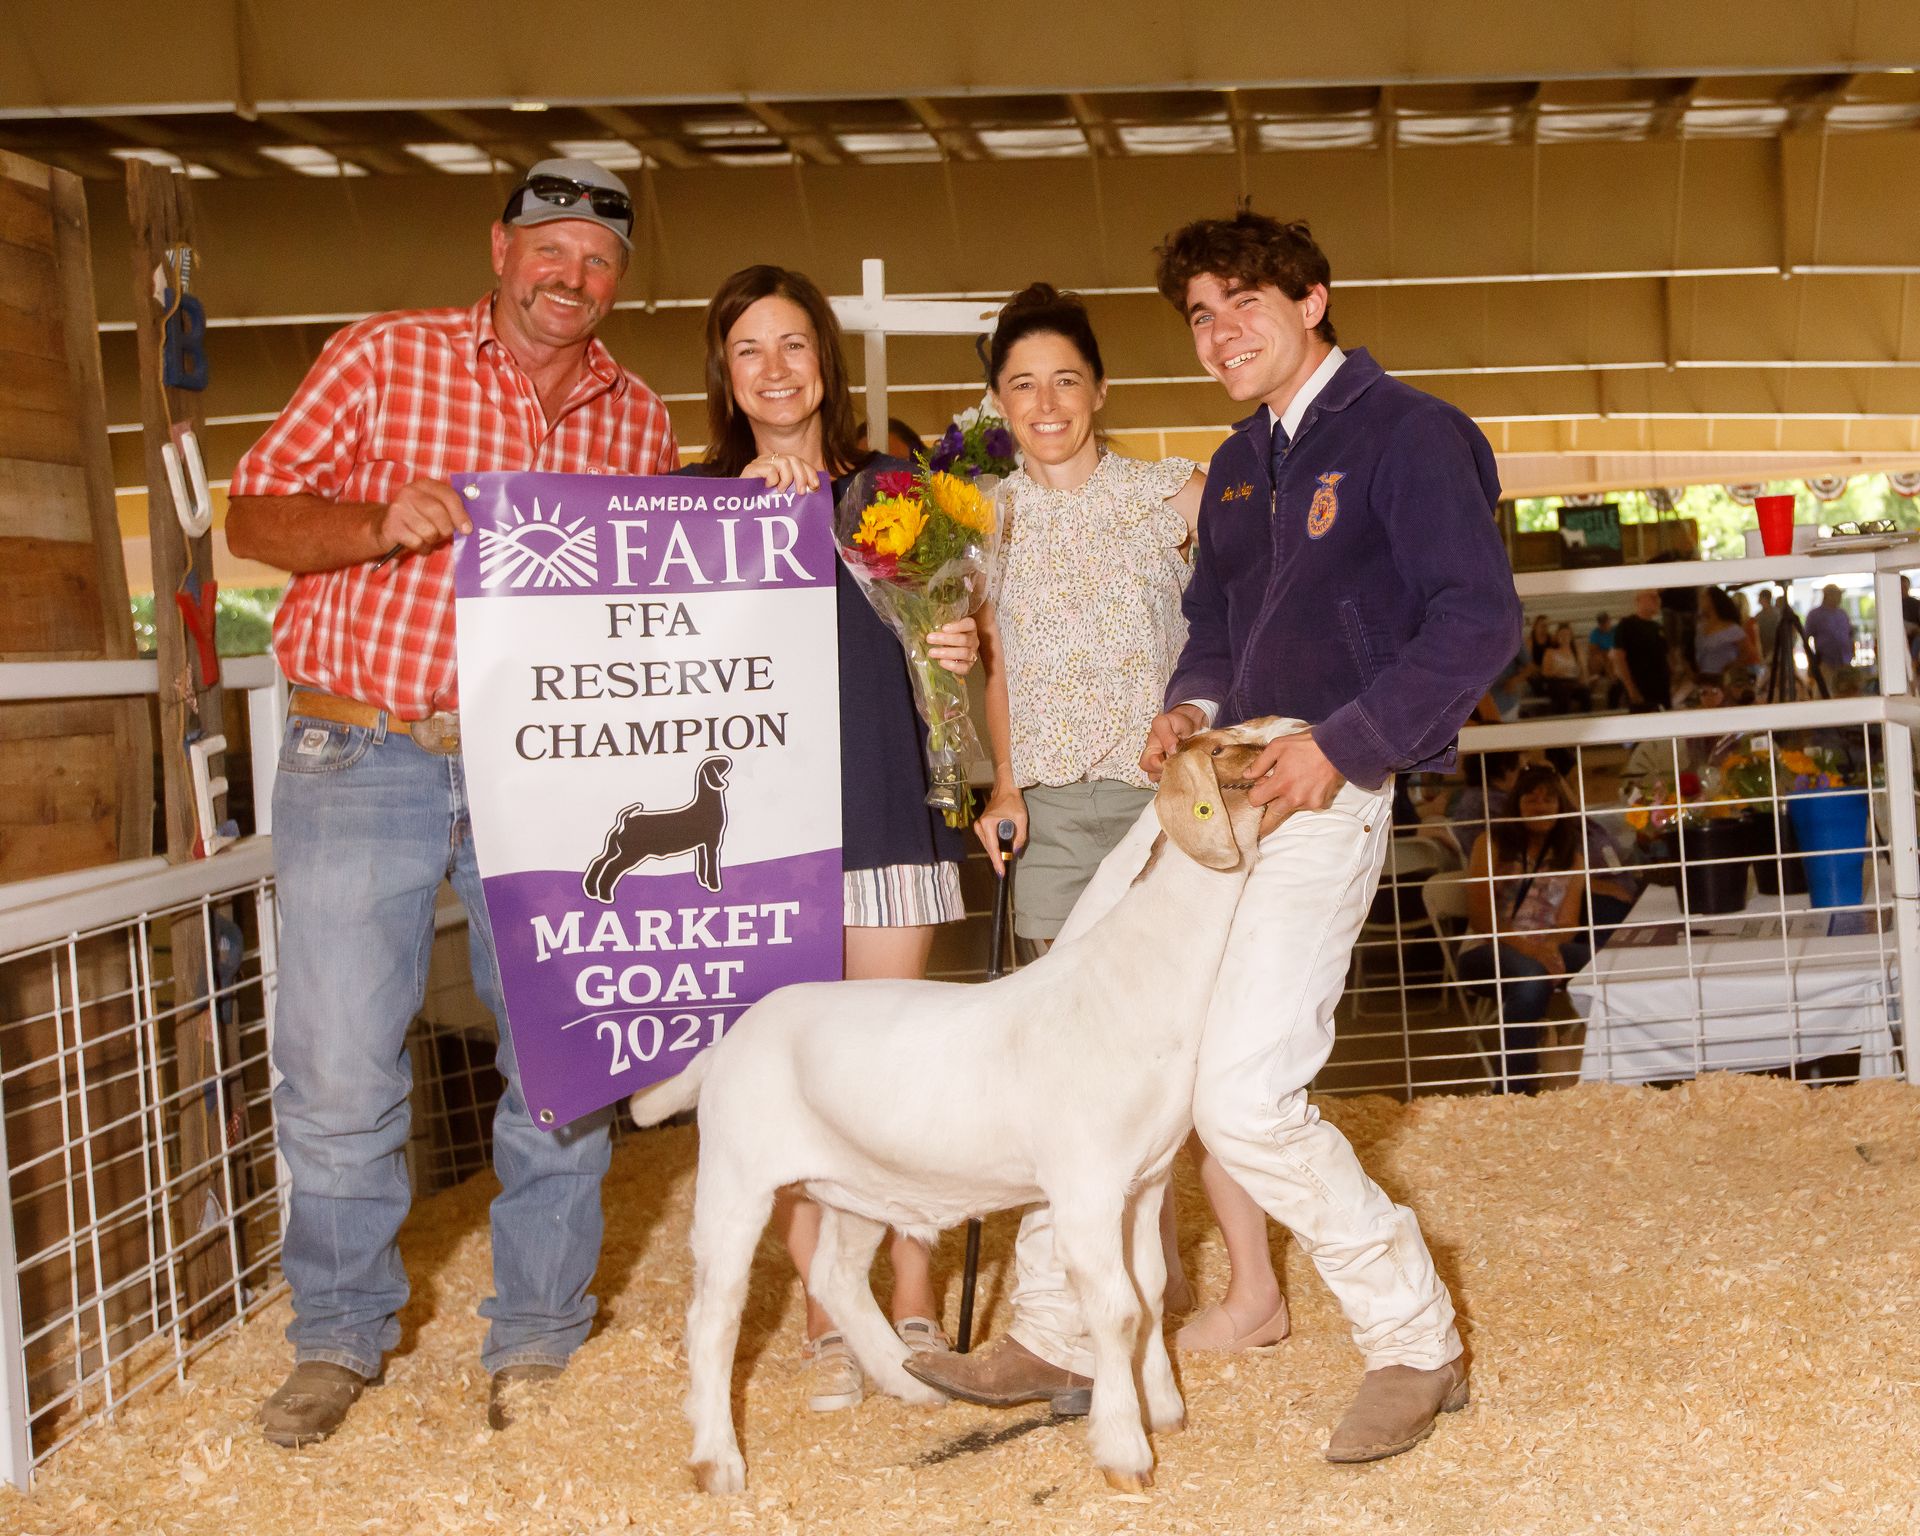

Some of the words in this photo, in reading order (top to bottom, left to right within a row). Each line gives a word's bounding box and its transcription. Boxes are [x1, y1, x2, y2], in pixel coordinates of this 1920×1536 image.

[608, 494, 708, 512] ALAMEDA
[713, 492, 796, 511] COUNTY
[607, 515, 816, 587] FAIR
[605, 602, 700, 638] FFA
[530, 655, 775, 701] RESERVE
[515, 712, 789, 760] CHAMPION
[530, 901, 800, 962] MARKET
[575, 960, 744, 1007] GOAT
[596, 1012, 726, 1076] 2021
